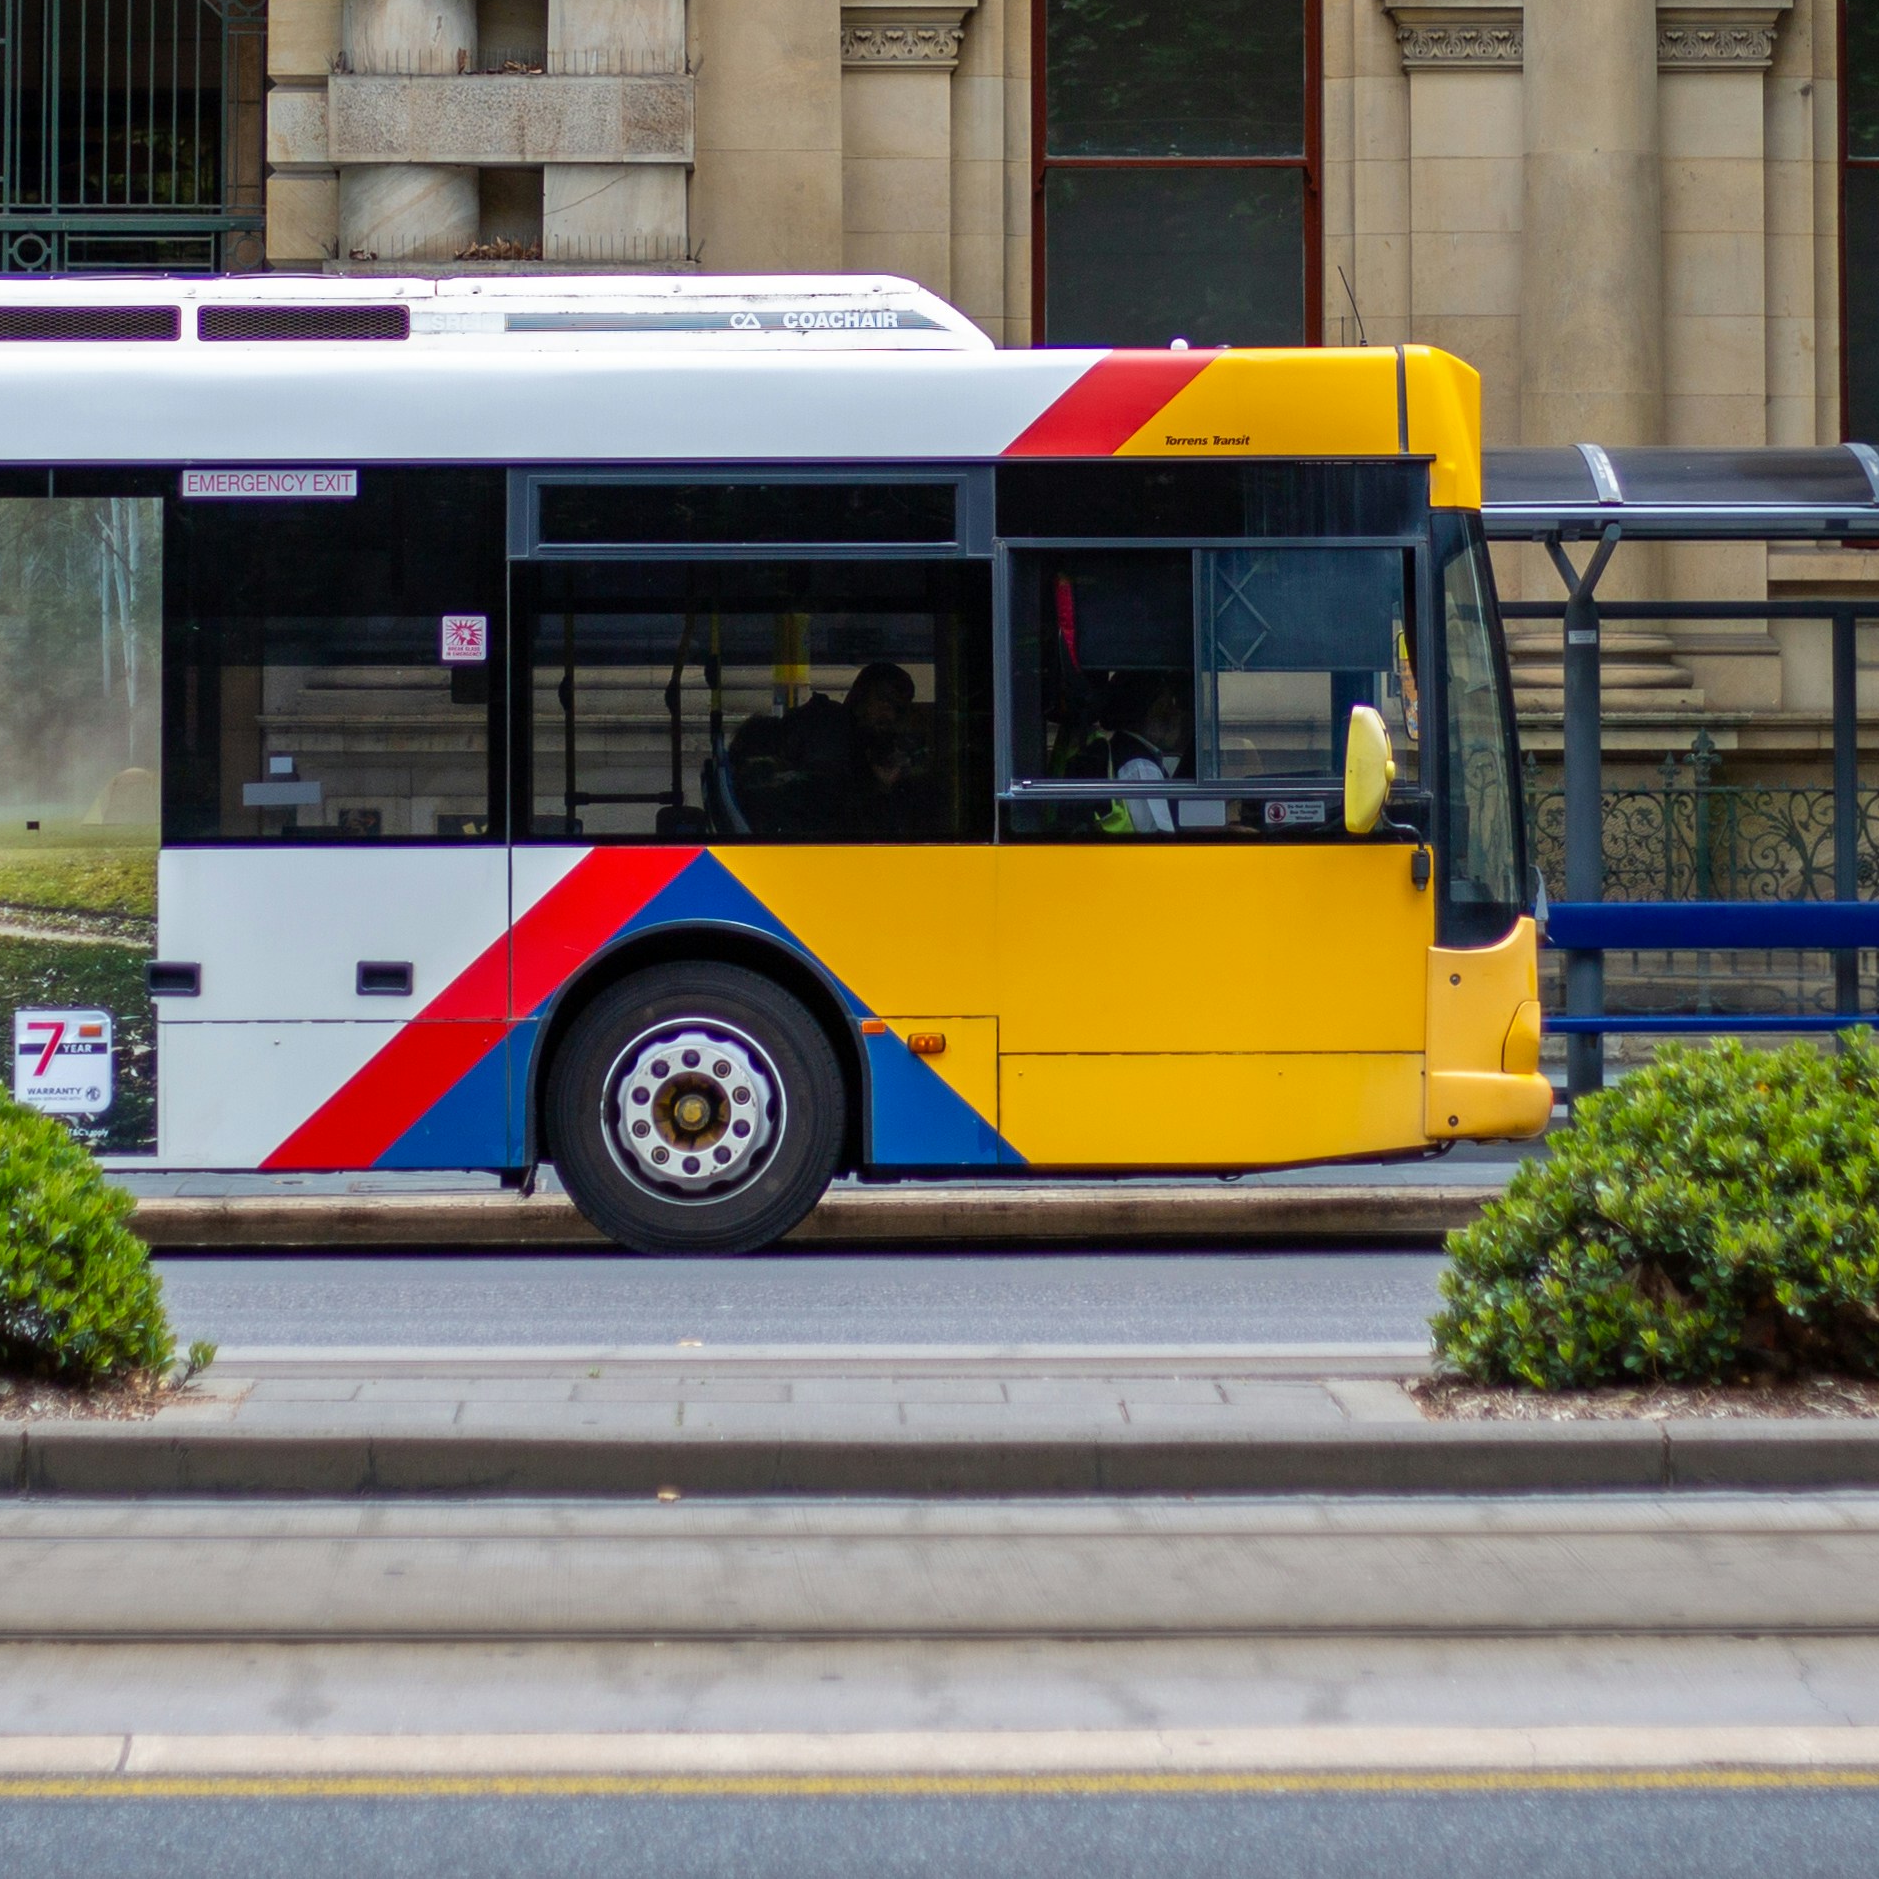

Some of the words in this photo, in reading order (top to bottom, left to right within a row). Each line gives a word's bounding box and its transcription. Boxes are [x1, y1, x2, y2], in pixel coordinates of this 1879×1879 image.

[782, 312, 899, 328] COACHAIR
[1164, 435, 1208, 446] Torrens
[1212, 434, 1250, 445] Transit
[187, 474, 307, 492] EMERGENCY
[313, 473, 353, 492] EXIT
[26, 1021, 66, 1077] 7
[62, 1044, 92, 1053] YEAR
[26, 1087, 82, 1095] WARRANTY
